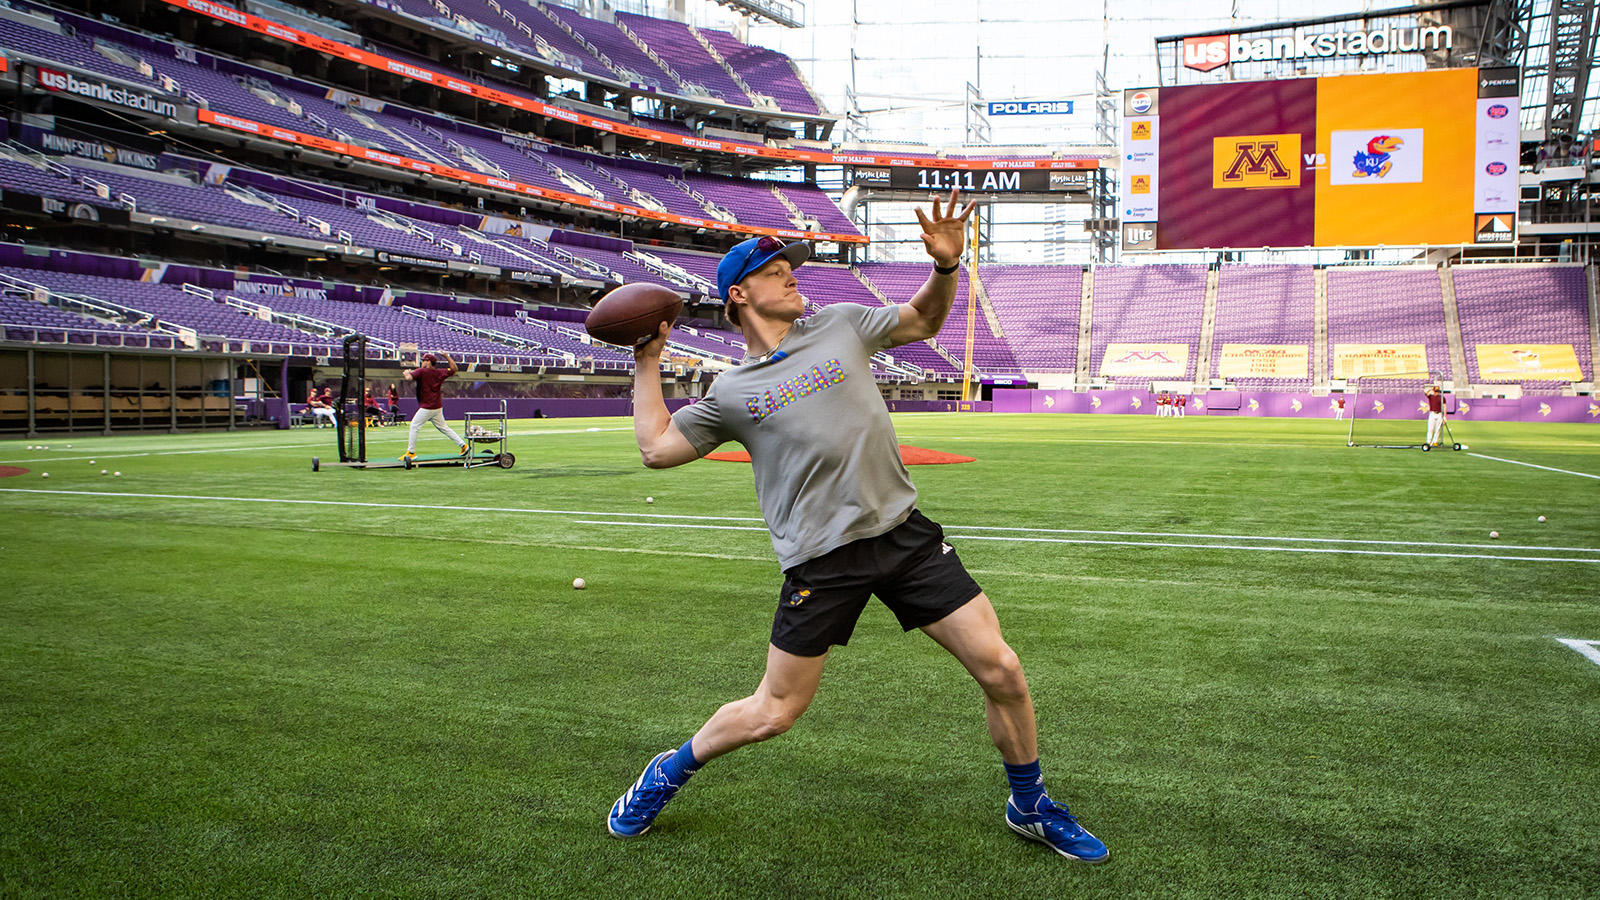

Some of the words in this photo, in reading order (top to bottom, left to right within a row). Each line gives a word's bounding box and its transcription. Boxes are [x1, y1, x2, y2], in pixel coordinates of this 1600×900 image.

[992, 102, 1070, 114] POLARIS
[42, 133, 105, 160] MINNESOTA
[116, 148, 157, 170] VIKINGS
[682, 138, 697, 147] POST
[696, 139, 722, 150] MALONE
[832, 155, 849, 163] POST
[848, 156, 875, 164] MALONE
[992, 161, 1009, 169] POST
[1008, 161, 1036, 169] MALONE
[1366, 157, 1379, 167] KU
[918, 169, 976, 190] 11:11
[982, 171, 1021, 190] AM
[356, 195, 377, 212] SKOL
[1127, 228, 1153, 245] Lite
[233, 279, 284, 297] MINNESOTA
[294, 286, 328, 301] VIKINGS
[745, 358, 846, 424] KANSAS
